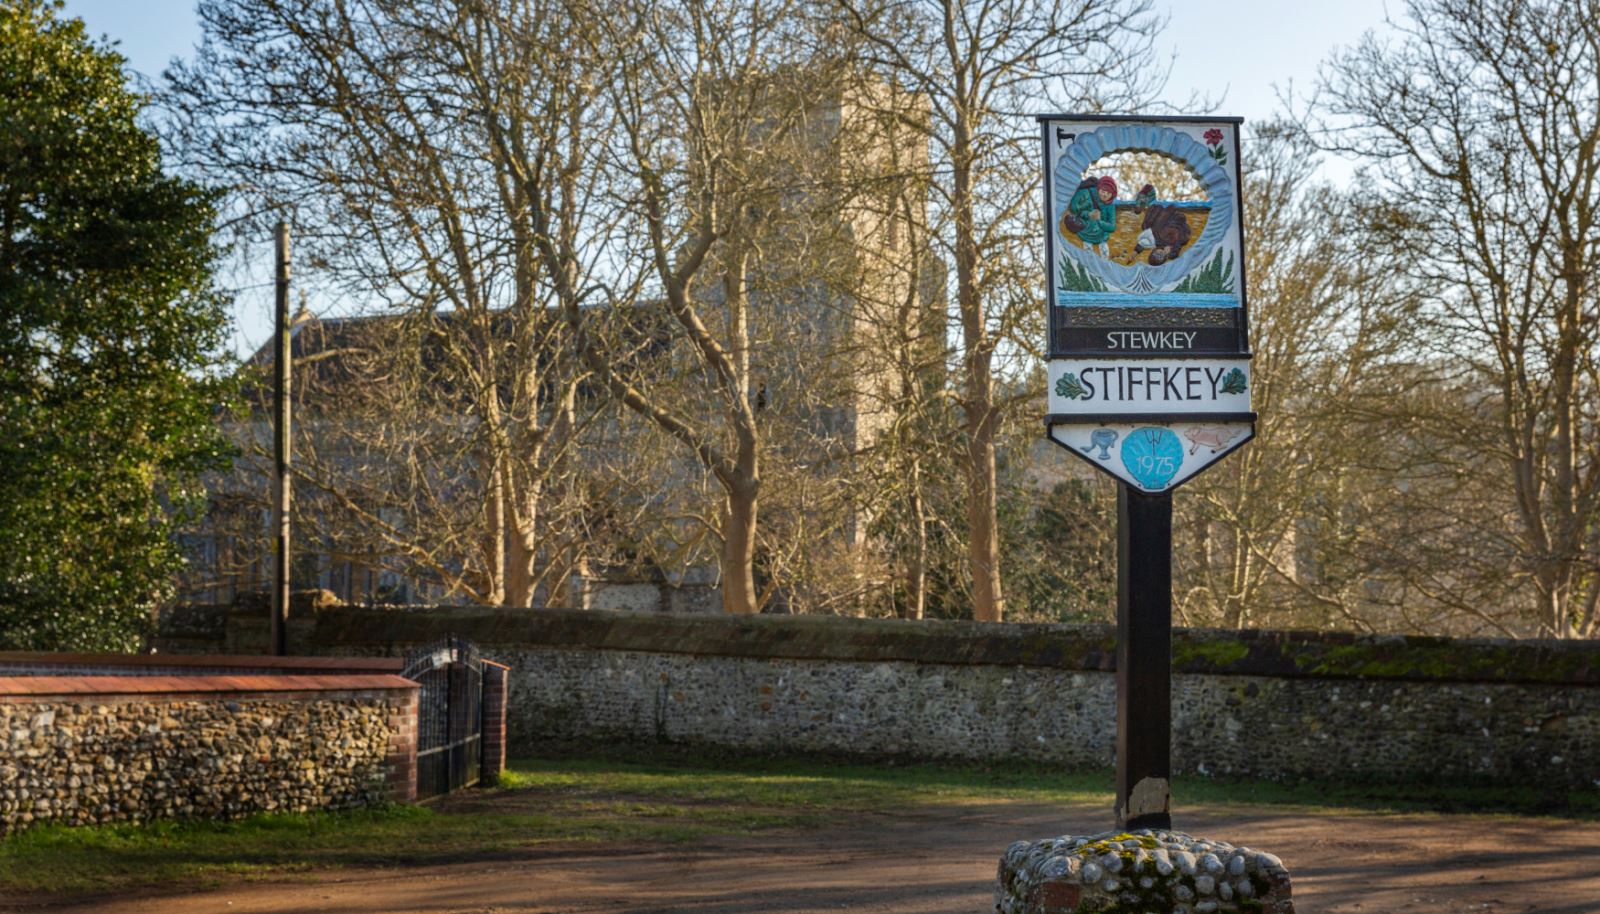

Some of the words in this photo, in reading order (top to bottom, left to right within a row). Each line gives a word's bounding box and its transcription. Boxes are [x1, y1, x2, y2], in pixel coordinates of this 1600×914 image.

[1107, 331, 1197, 349] STEWKEY
[1080, 366, 1226, 401] STIFFKEY
[1136, 455, 1175, 475] 1975
